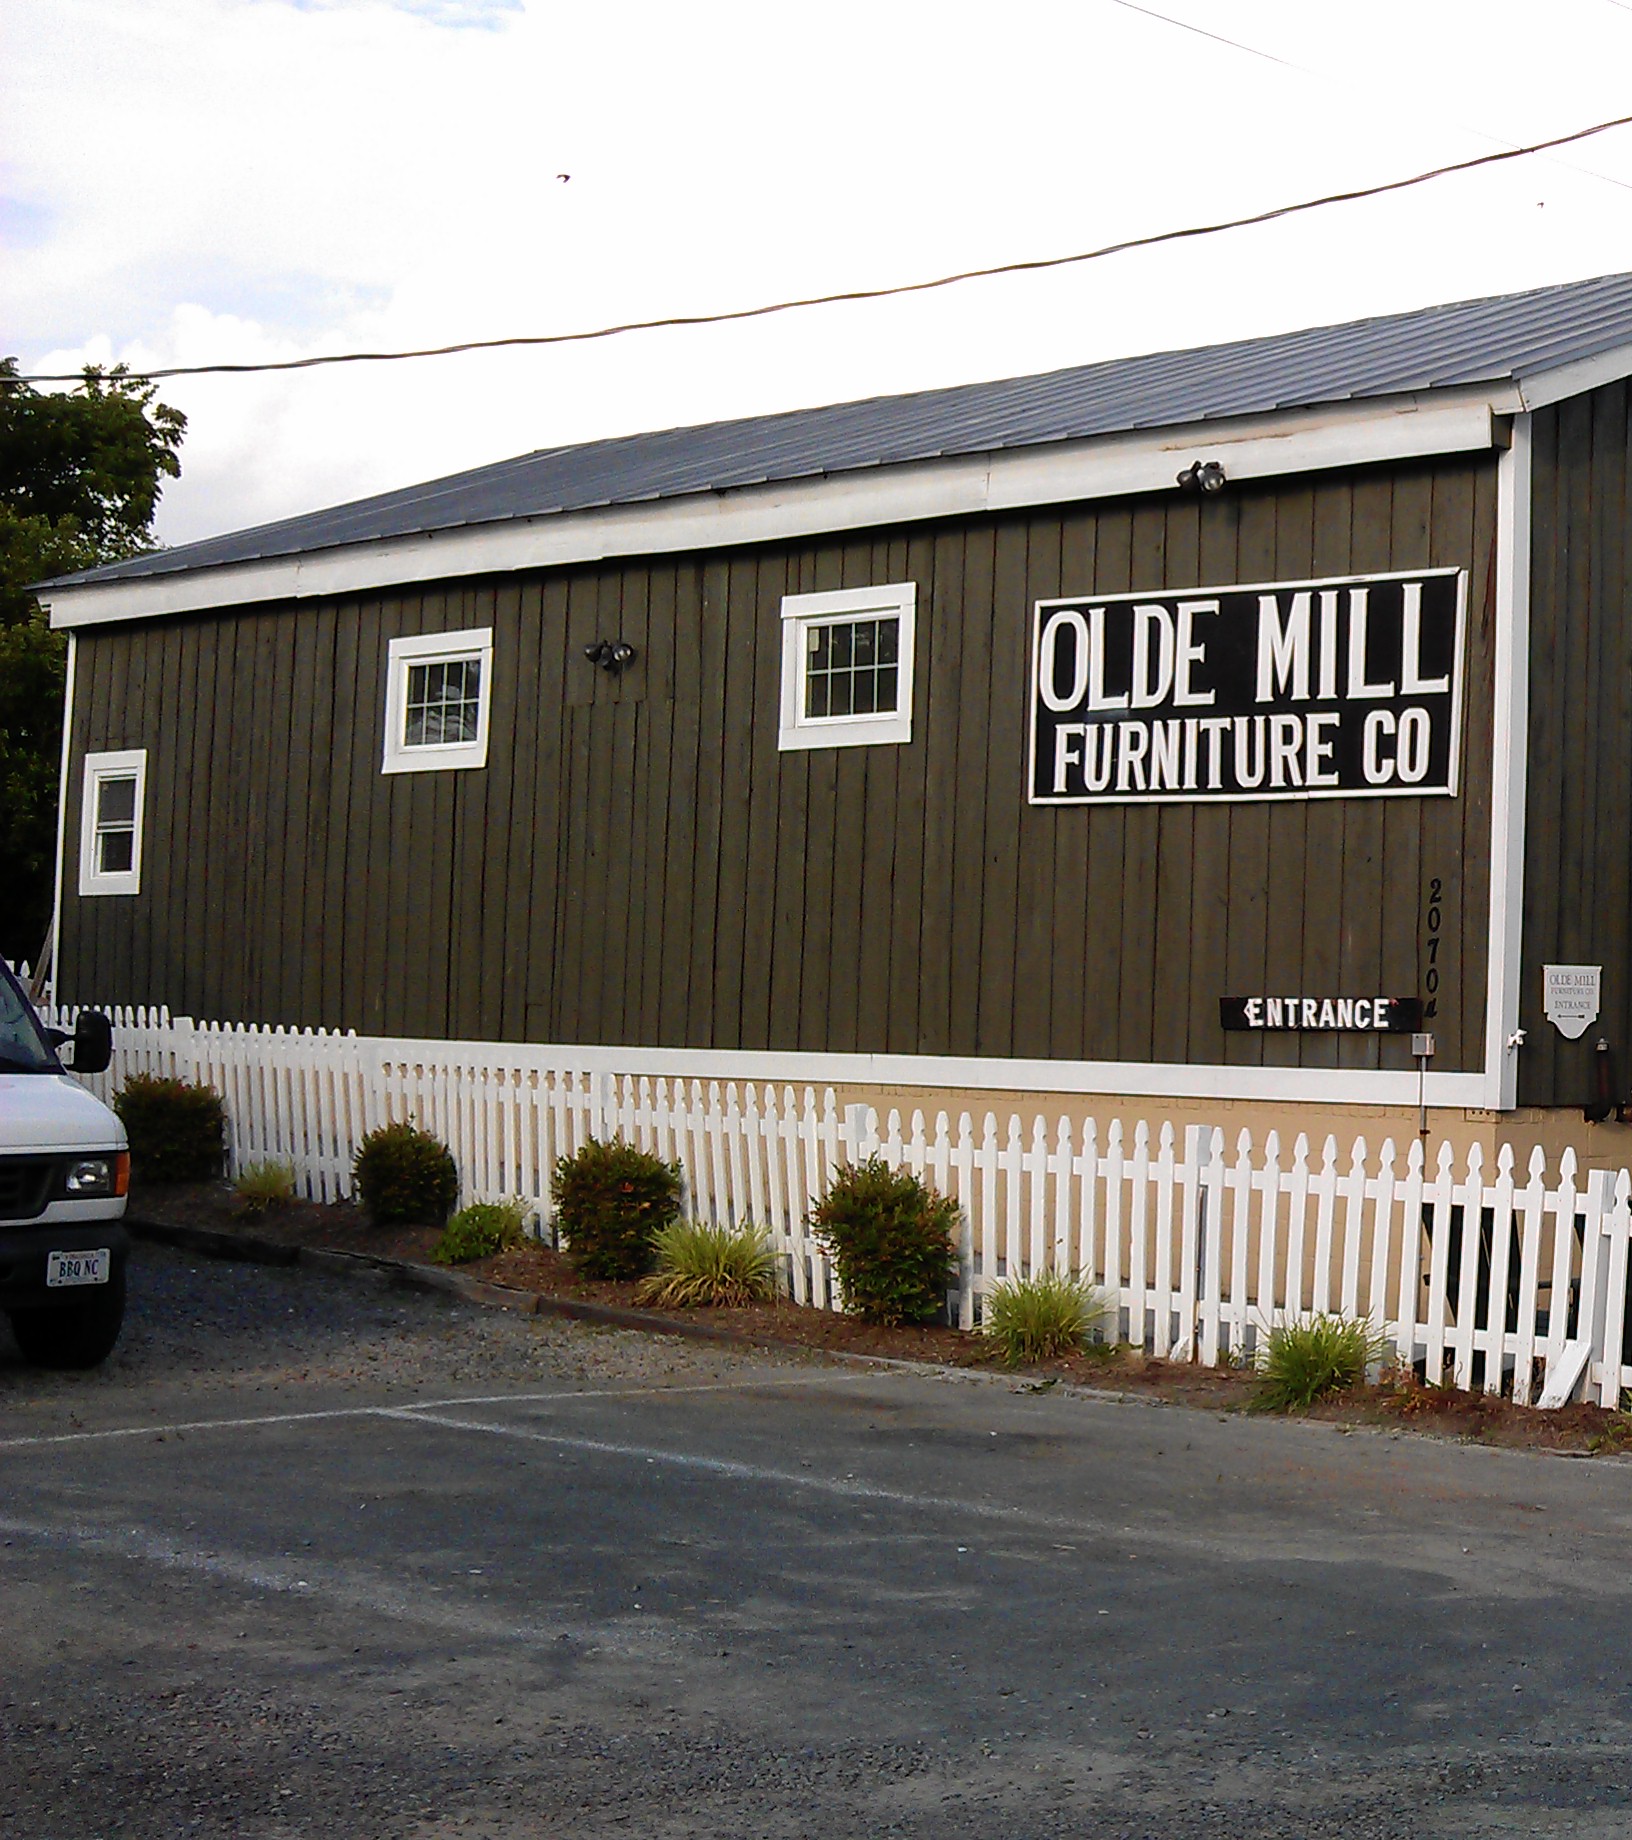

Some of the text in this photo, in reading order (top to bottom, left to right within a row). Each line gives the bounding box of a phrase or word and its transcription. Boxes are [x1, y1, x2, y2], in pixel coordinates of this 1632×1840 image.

[1039, 583, 1449, 712] OLDE MILL
[1053, 707, 1431, 793] FURNITURE CO
[1550, 975, 1595, 986] OLDE MILL
[1249, 998, 1389, 1029] ENTRANCE
[1554, 1001, 1591, 1009] ENTRANCE
[84, 1259, 99, 1275] NC
